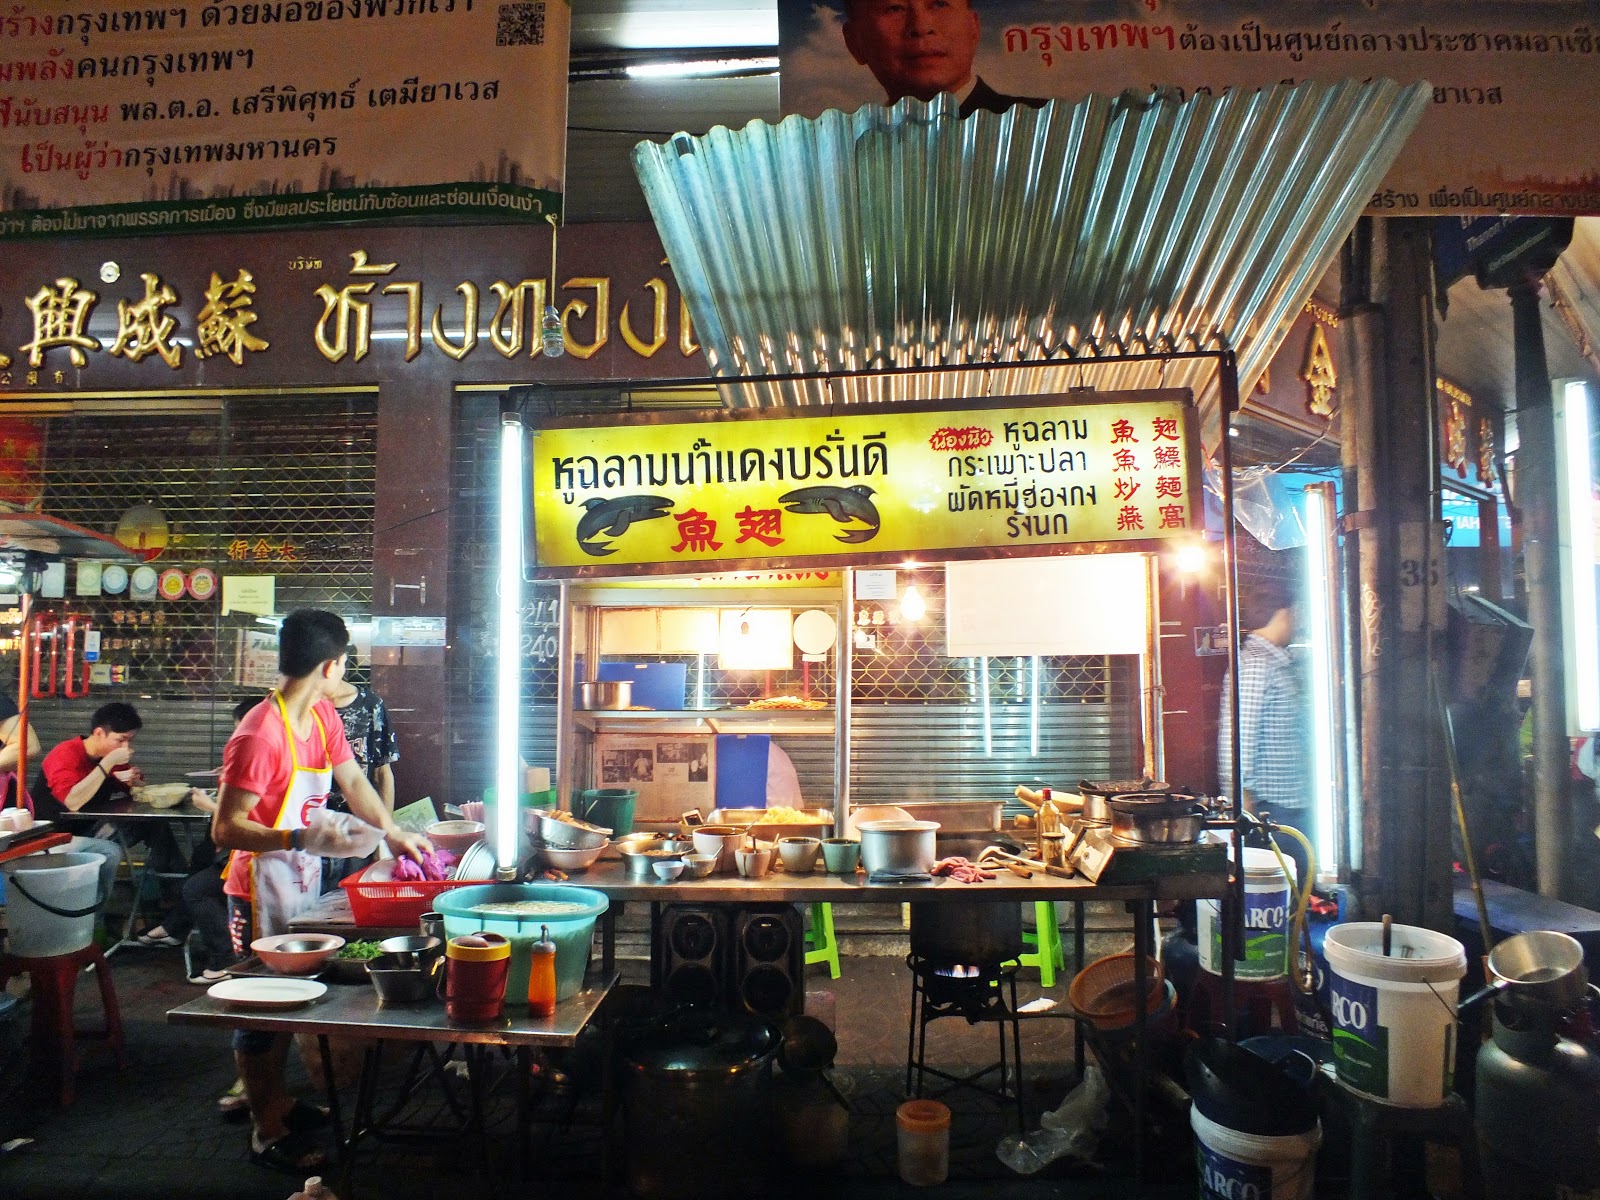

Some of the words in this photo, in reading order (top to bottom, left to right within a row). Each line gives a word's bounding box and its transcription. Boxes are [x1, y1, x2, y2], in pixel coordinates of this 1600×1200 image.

[0, 5, 187, 46] ร้างกรุงเทพฯ
[232, 77, 361, 122] เสรีพิศุทธ์
[368, 77, 500, 108] เตมียาเวส
[1003, 418, 1088, 451] หูฉลาม
[552, 429, 888, 504] หูฉลามน้ำแดงบรั่นดี
[948, 448, 1087, 478] กระเพาะปลา
[1006, 511, 1068, 538] รังนก
